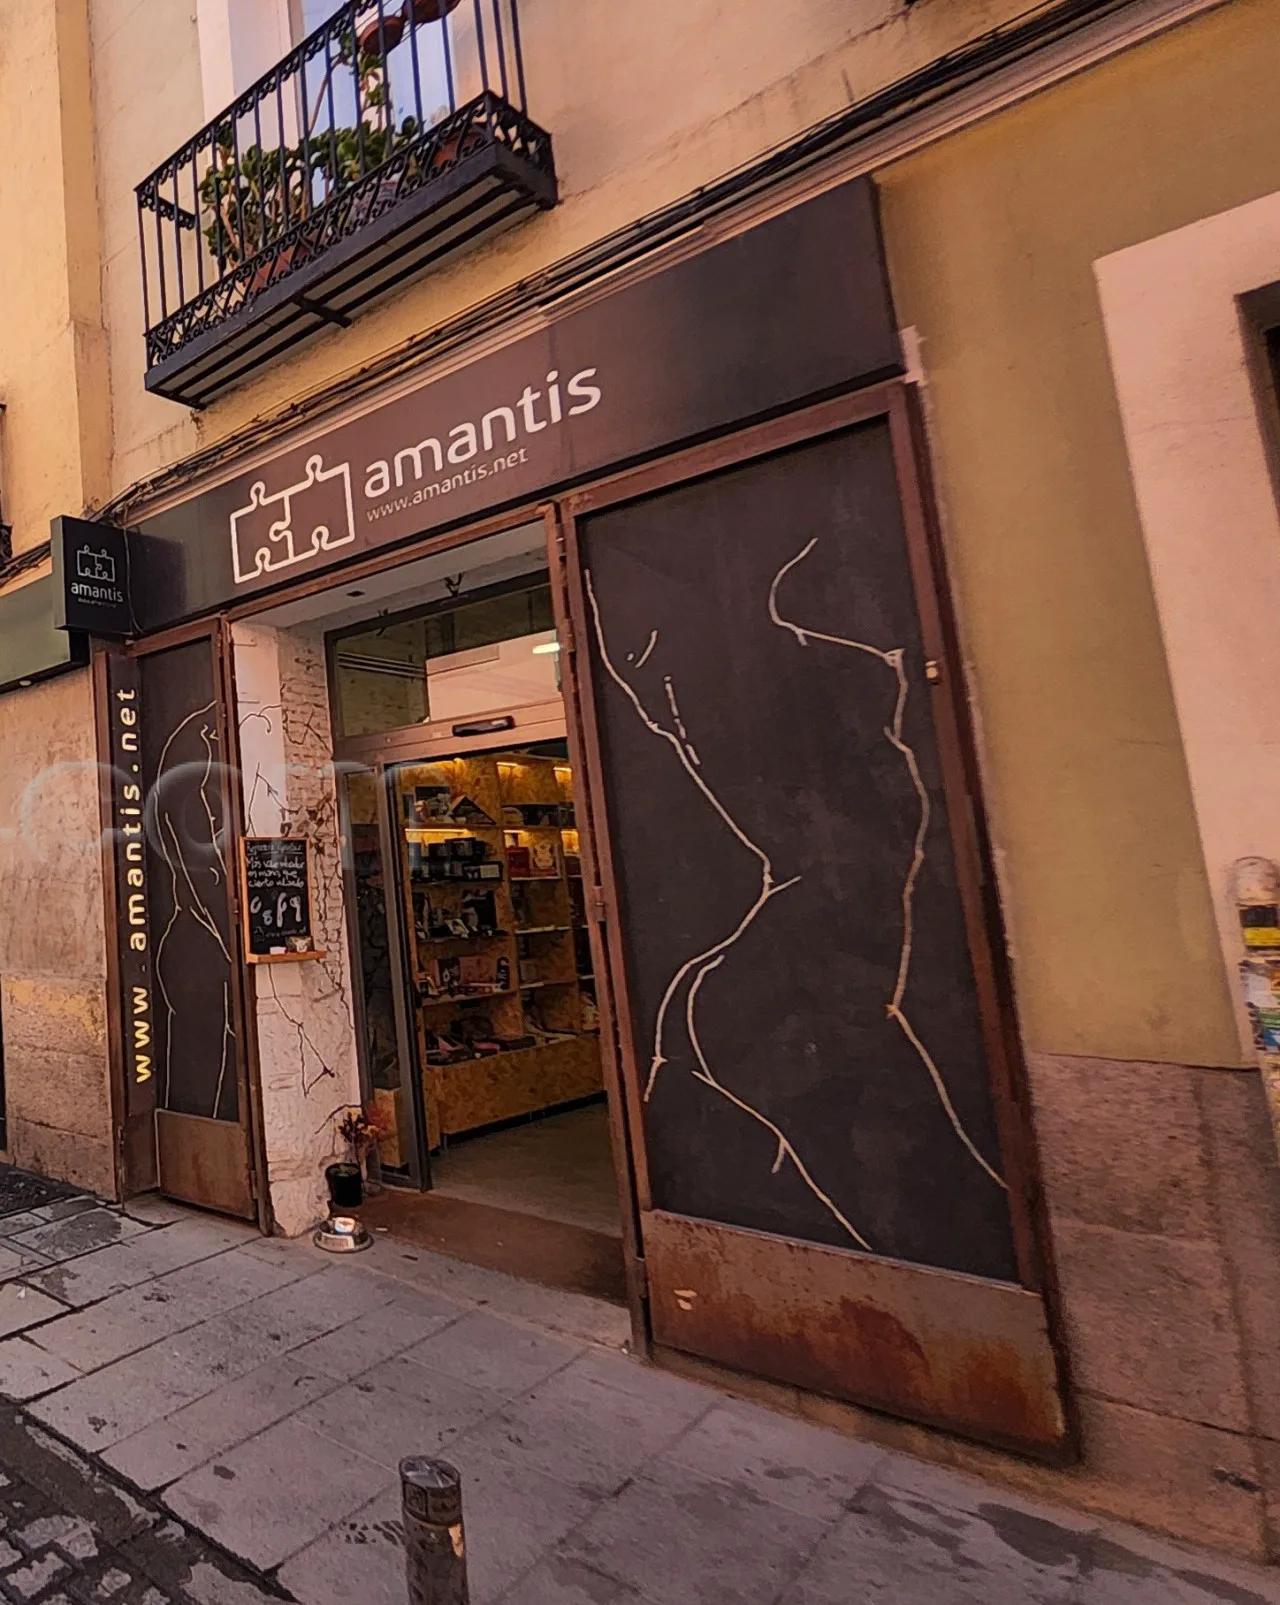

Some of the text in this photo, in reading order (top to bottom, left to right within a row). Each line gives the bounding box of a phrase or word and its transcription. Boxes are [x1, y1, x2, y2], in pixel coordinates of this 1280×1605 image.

[364, 367, 602, 498] amantis
[366, 447, 529, 523] www.amantis.net
[71, 582, 124, 603] amantis
